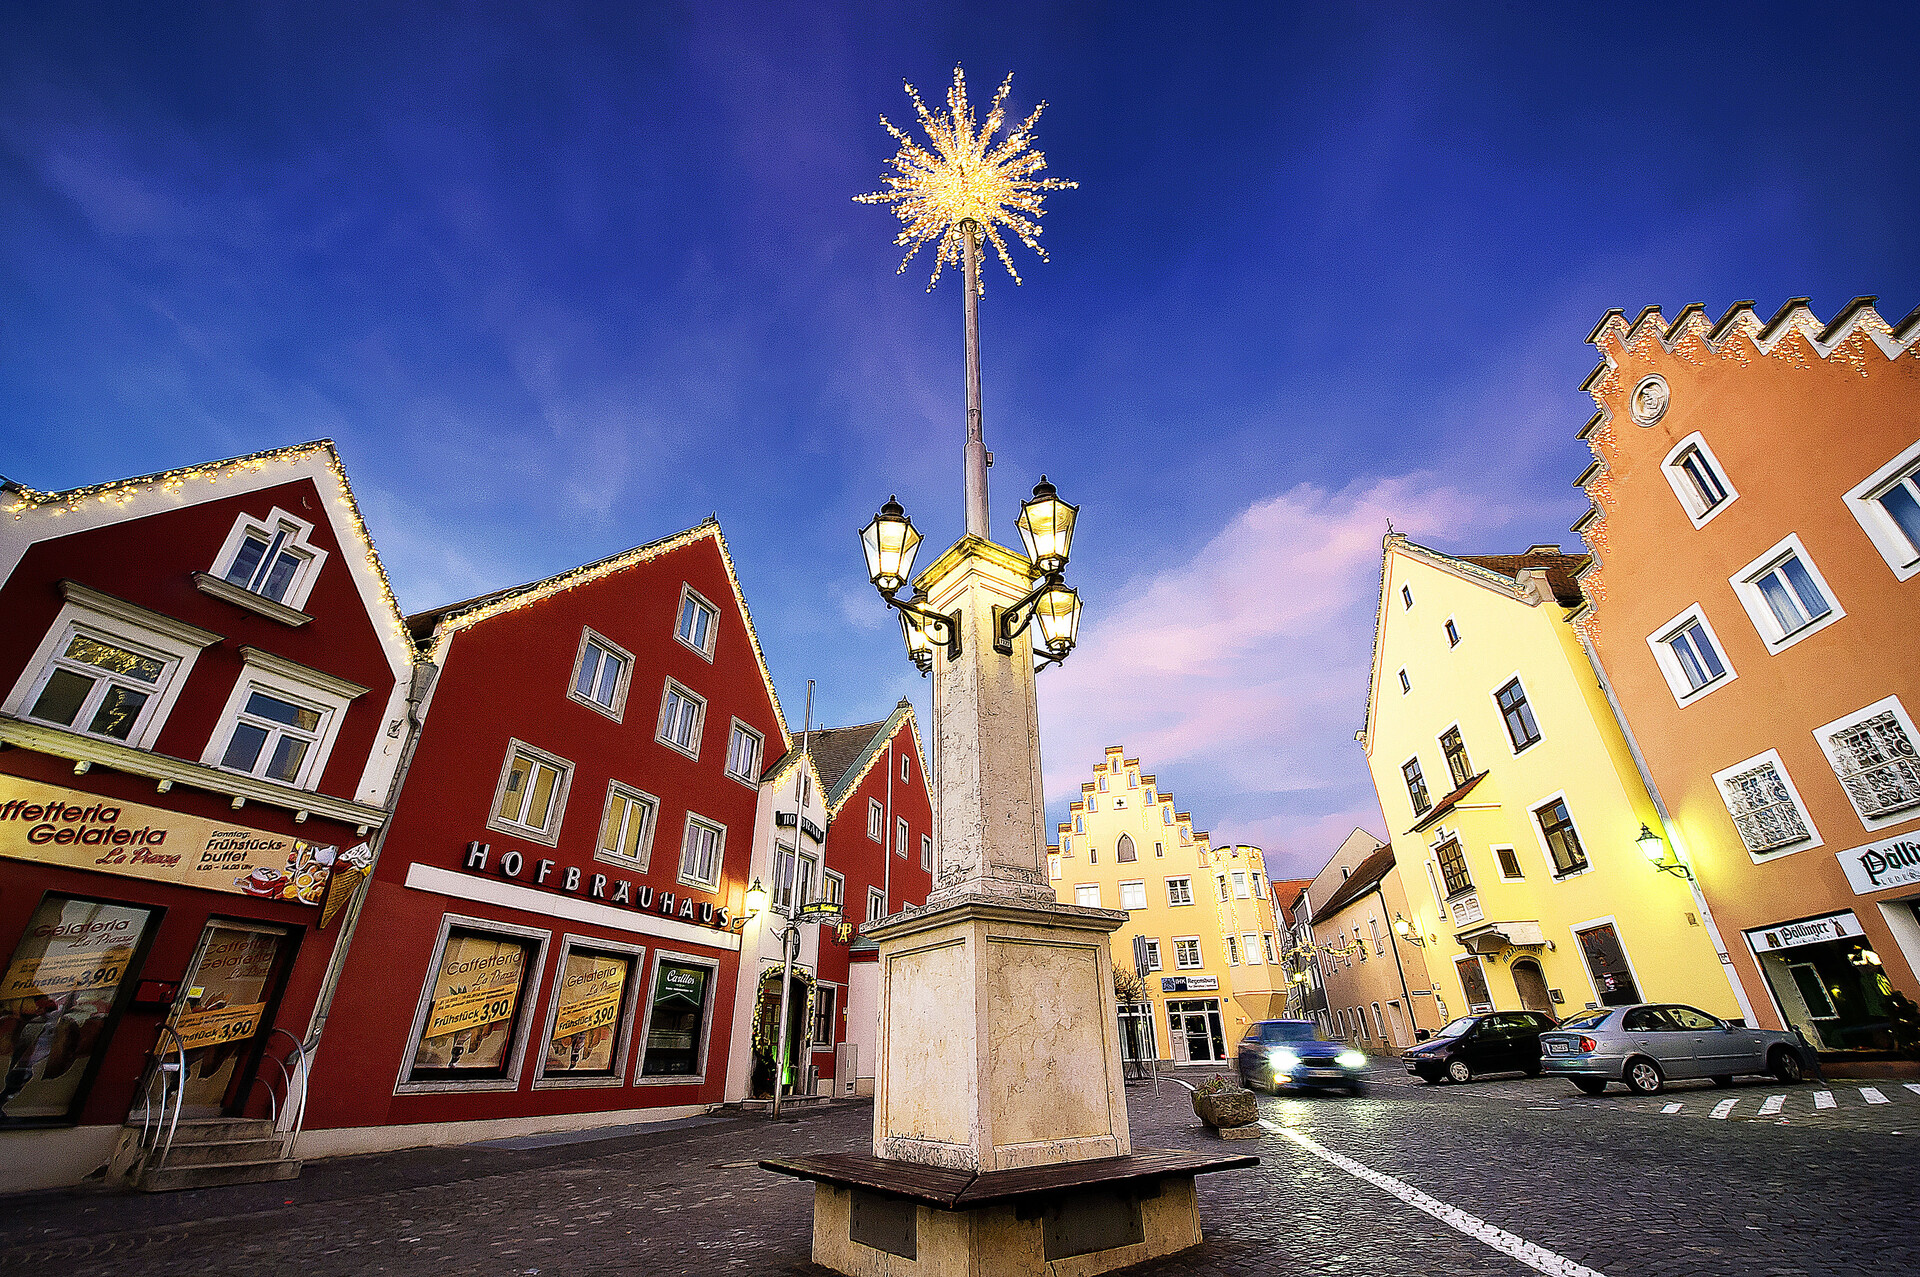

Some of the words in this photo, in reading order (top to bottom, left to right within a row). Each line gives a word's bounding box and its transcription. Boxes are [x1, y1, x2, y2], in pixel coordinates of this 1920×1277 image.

[0, 799, 121, 823] ffetteria
[27, 823, 167, 846] Gelateria
[205, 839, 287, 850] Frühstücks-
[95, 847, 127, 865] La
[130, 847, 182, 868] Piazza
[200, 851, 248, 862] buffet
[466, 840, 730, 927] HOFBRÄUHAUS
[34, 919, 130, 937] Gelateria
[1779, 922, 1830, 946] Pöllinger
[67, 935, 90, 948] La
[446, 952, 520, 976] Caffetteria
[11, 975, 75, 990] Frühstück
[472, 972, 488, 986] La
[567, 966, 617, 987] Gelateria
[433, 1008, 479, 1028] Frühstück
[558, 1014, 592, 1031] Frühstück
